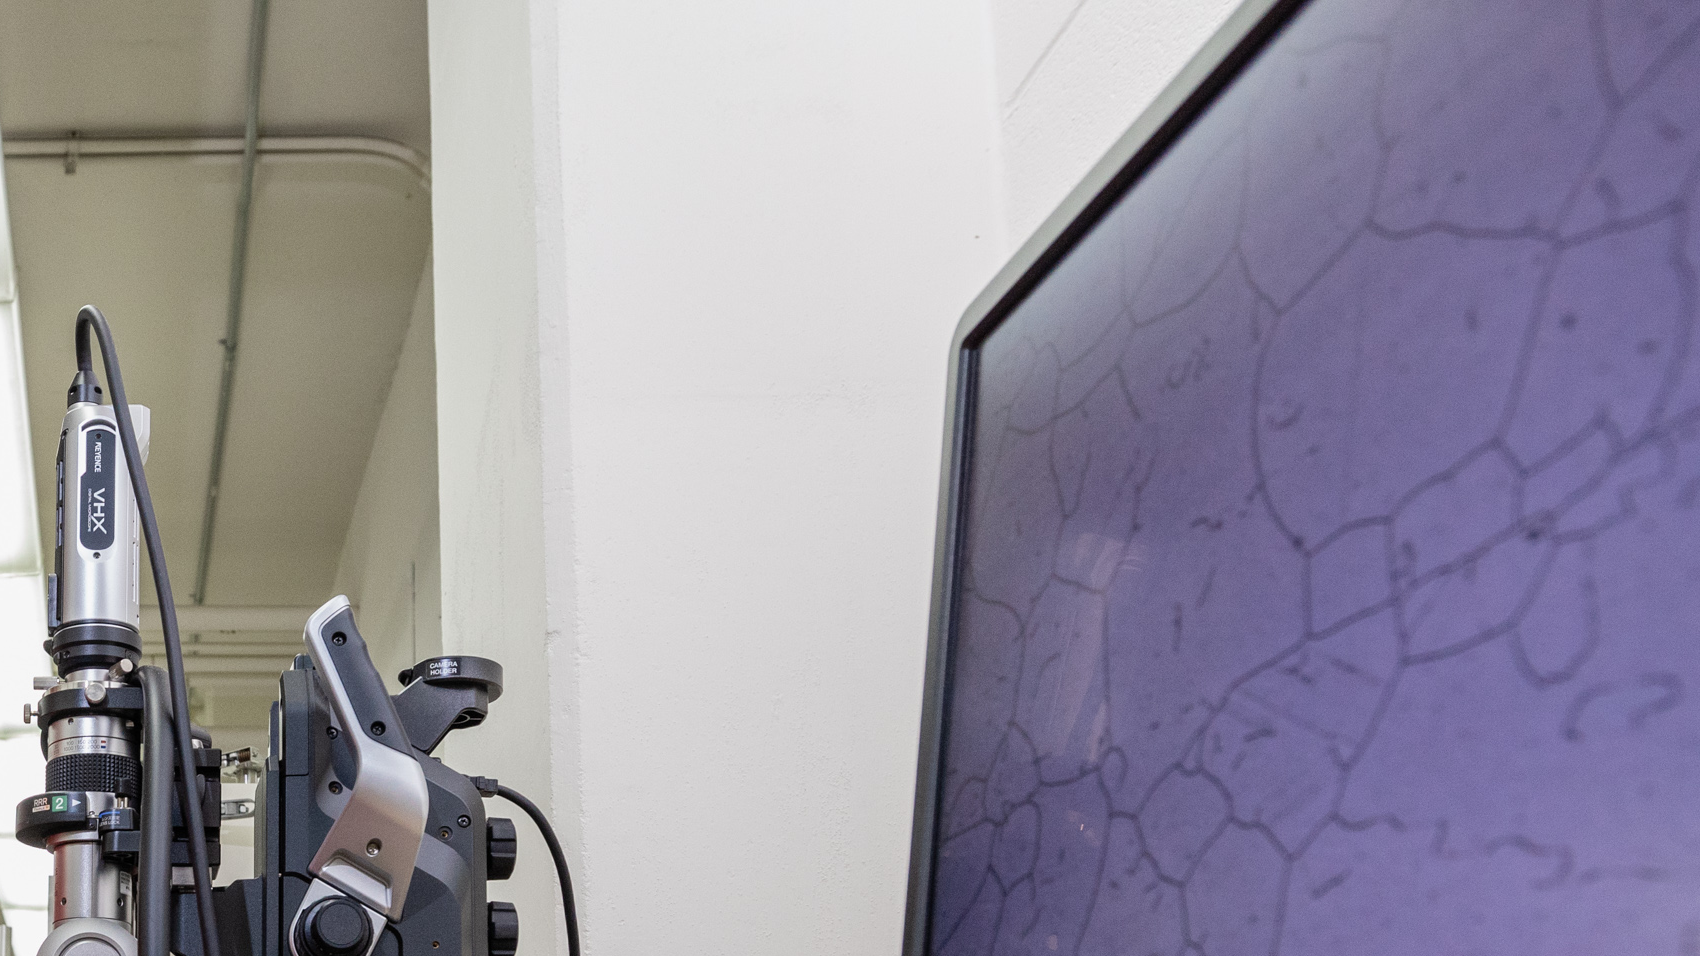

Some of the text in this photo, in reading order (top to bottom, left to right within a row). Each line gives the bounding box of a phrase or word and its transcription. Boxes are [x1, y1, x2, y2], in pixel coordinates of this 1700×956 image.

[94, 442, 102, 473] KEYENCE
[91, 488, 107, 535] VHX
[430, 661, 458, 669] CAMERA
[33, 797, 48, 807] RRR
[55, 797, 64, 810] 2
